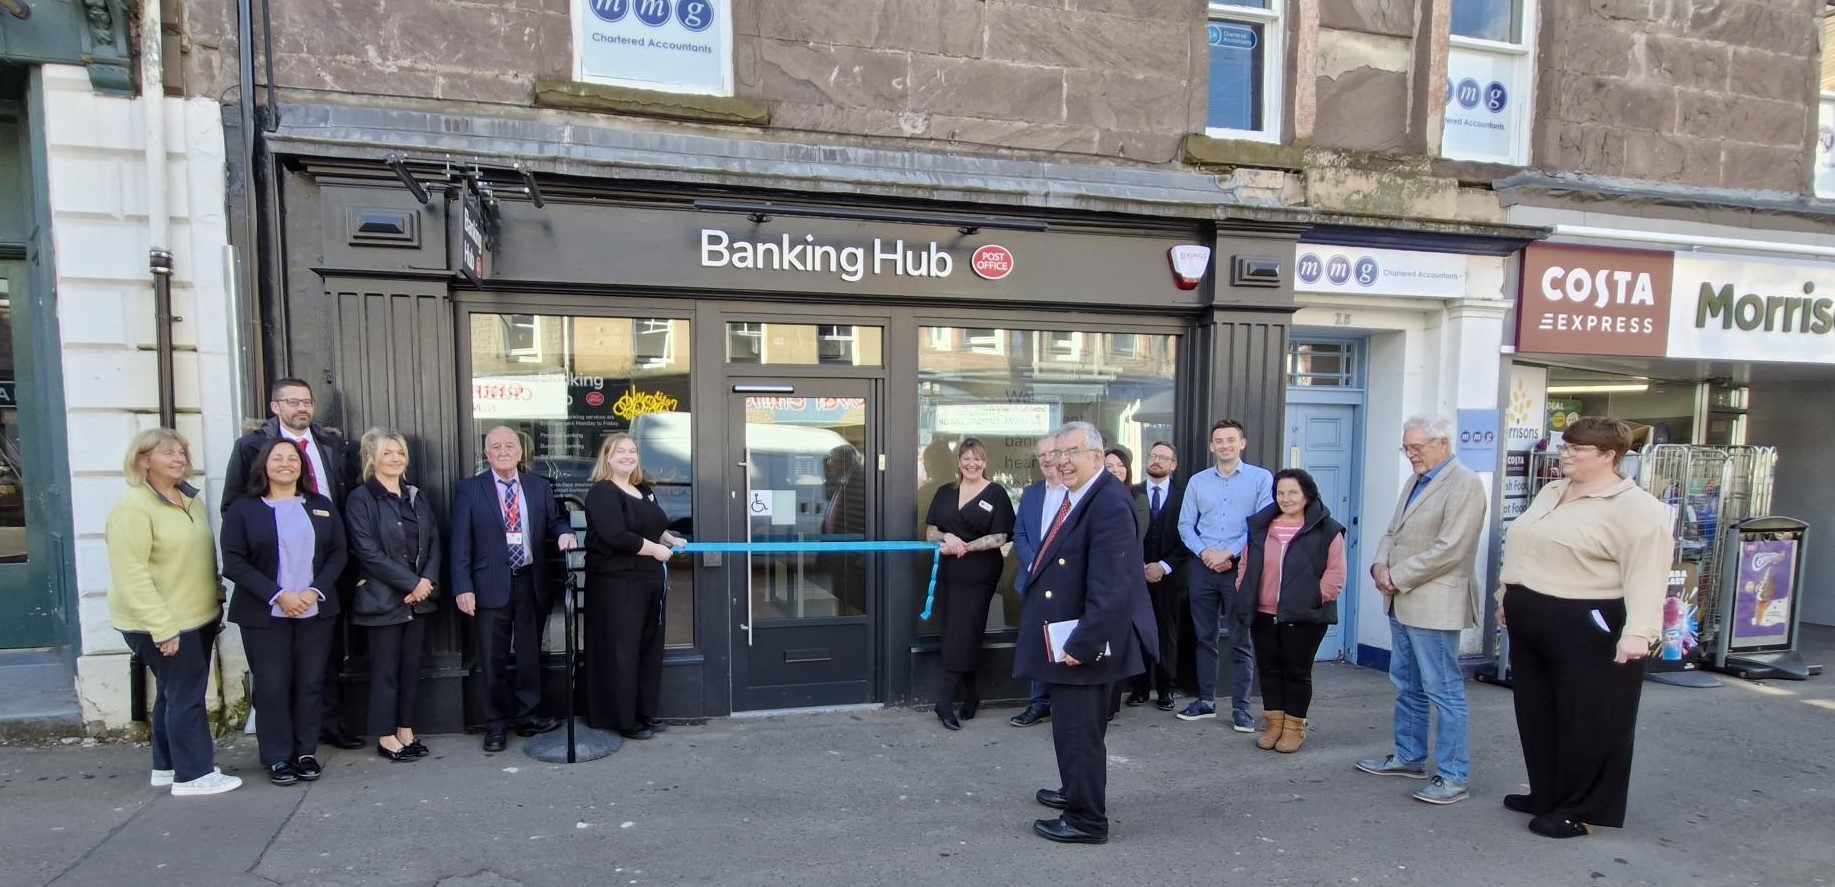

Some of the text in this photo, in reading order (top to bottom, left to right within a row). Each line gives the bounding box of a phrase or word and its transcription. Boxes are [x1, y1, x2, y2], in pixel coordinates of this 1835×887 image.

[592, 32, 713, 53] Chartered Accountants
[1444, 116, 1505, 130] tered Accountants
[464, 207, 482, 255] Banking
[464, 240, 475, 271] Hub
[701, 229, 953, 282] Banking Hub
[976, 260, 1008, 271] OFFICE
[982, 251, 1005, 261] POST
[1383, 268, 1460, 281] Chartered Accountants
[1541, 266, 1654, 308] COSTA
[1696, 280, 1835, 335] Morris
[1557, 314, 1653, 334] EXPRESS
[1508, 419, 1539, 439] rrisons
[1507, 455, 1525, 465] COSTA
